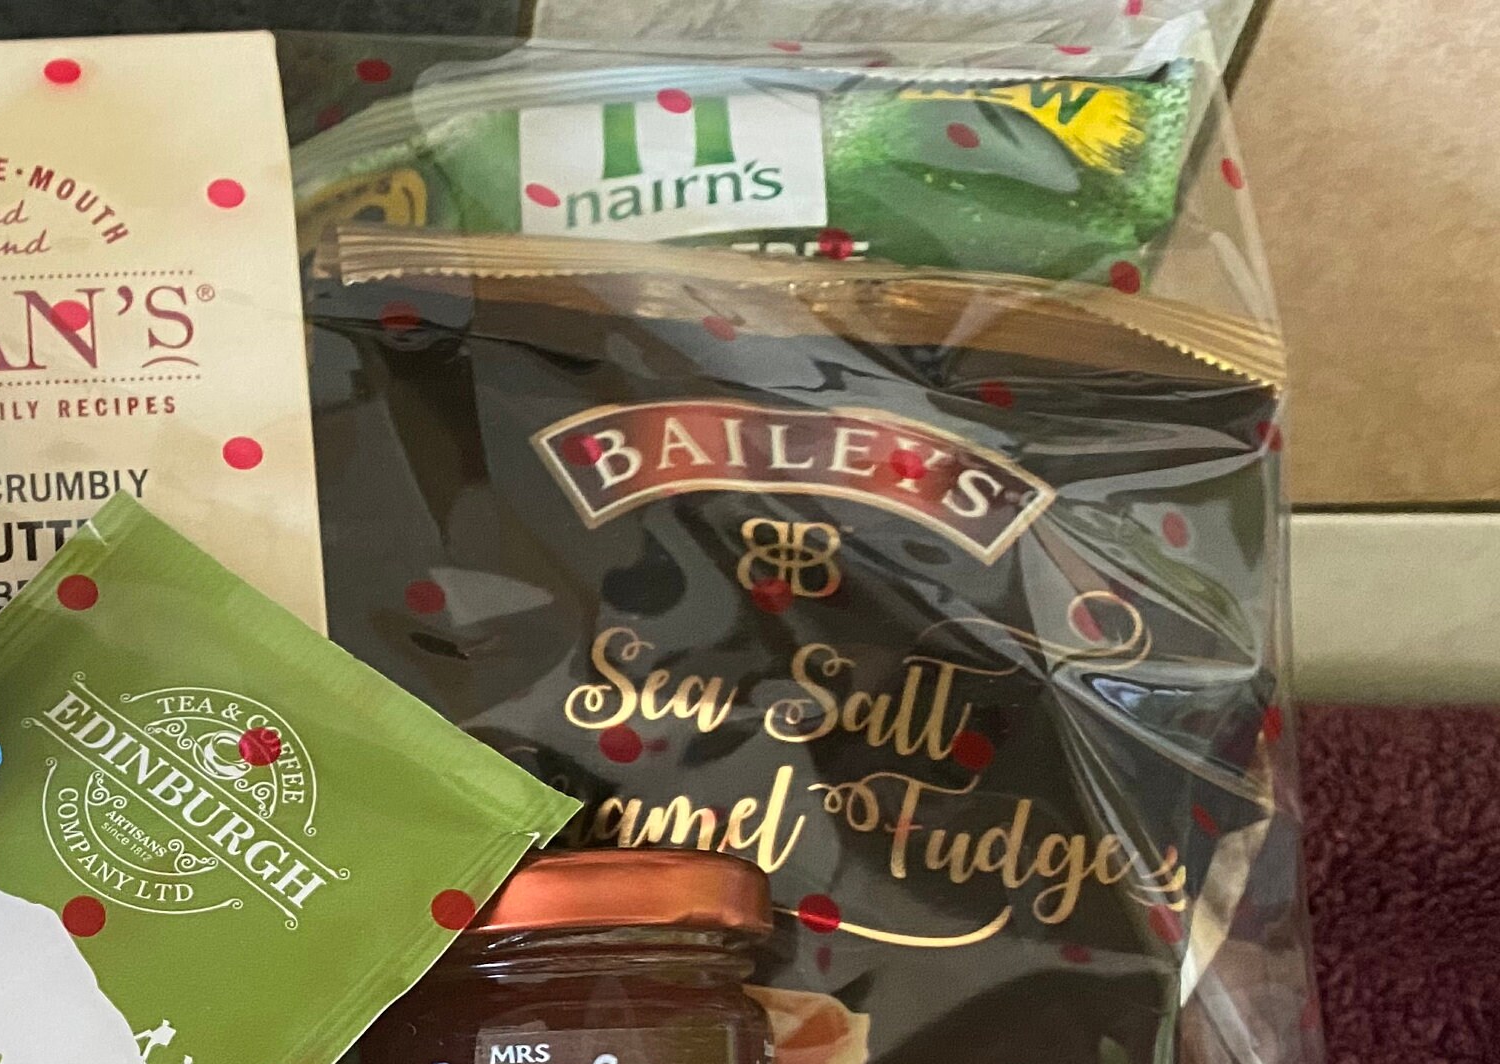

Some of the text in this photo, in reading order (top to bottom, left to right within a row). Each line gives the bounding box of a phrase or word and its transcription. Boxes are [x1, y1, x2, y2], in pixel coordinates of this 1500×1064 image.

[565, 159, 785, 228] nairn's
[57, 396, 177, 418] RECIPES
[591, 415, 1004, 519] BAILEYS
[564, 626, 998, 761] Sea Salt
[43, 690, 327, 909] EDINBURGH
[156, 695, 305, 804] TEA & COFFEE
[58, 787, 194, 902] COMPANY LTD
[100, 821, 153, 862] since 1812
[105, 810, 168, 857] ARTISANS
[806, 771, 1160, 926] Fudge
